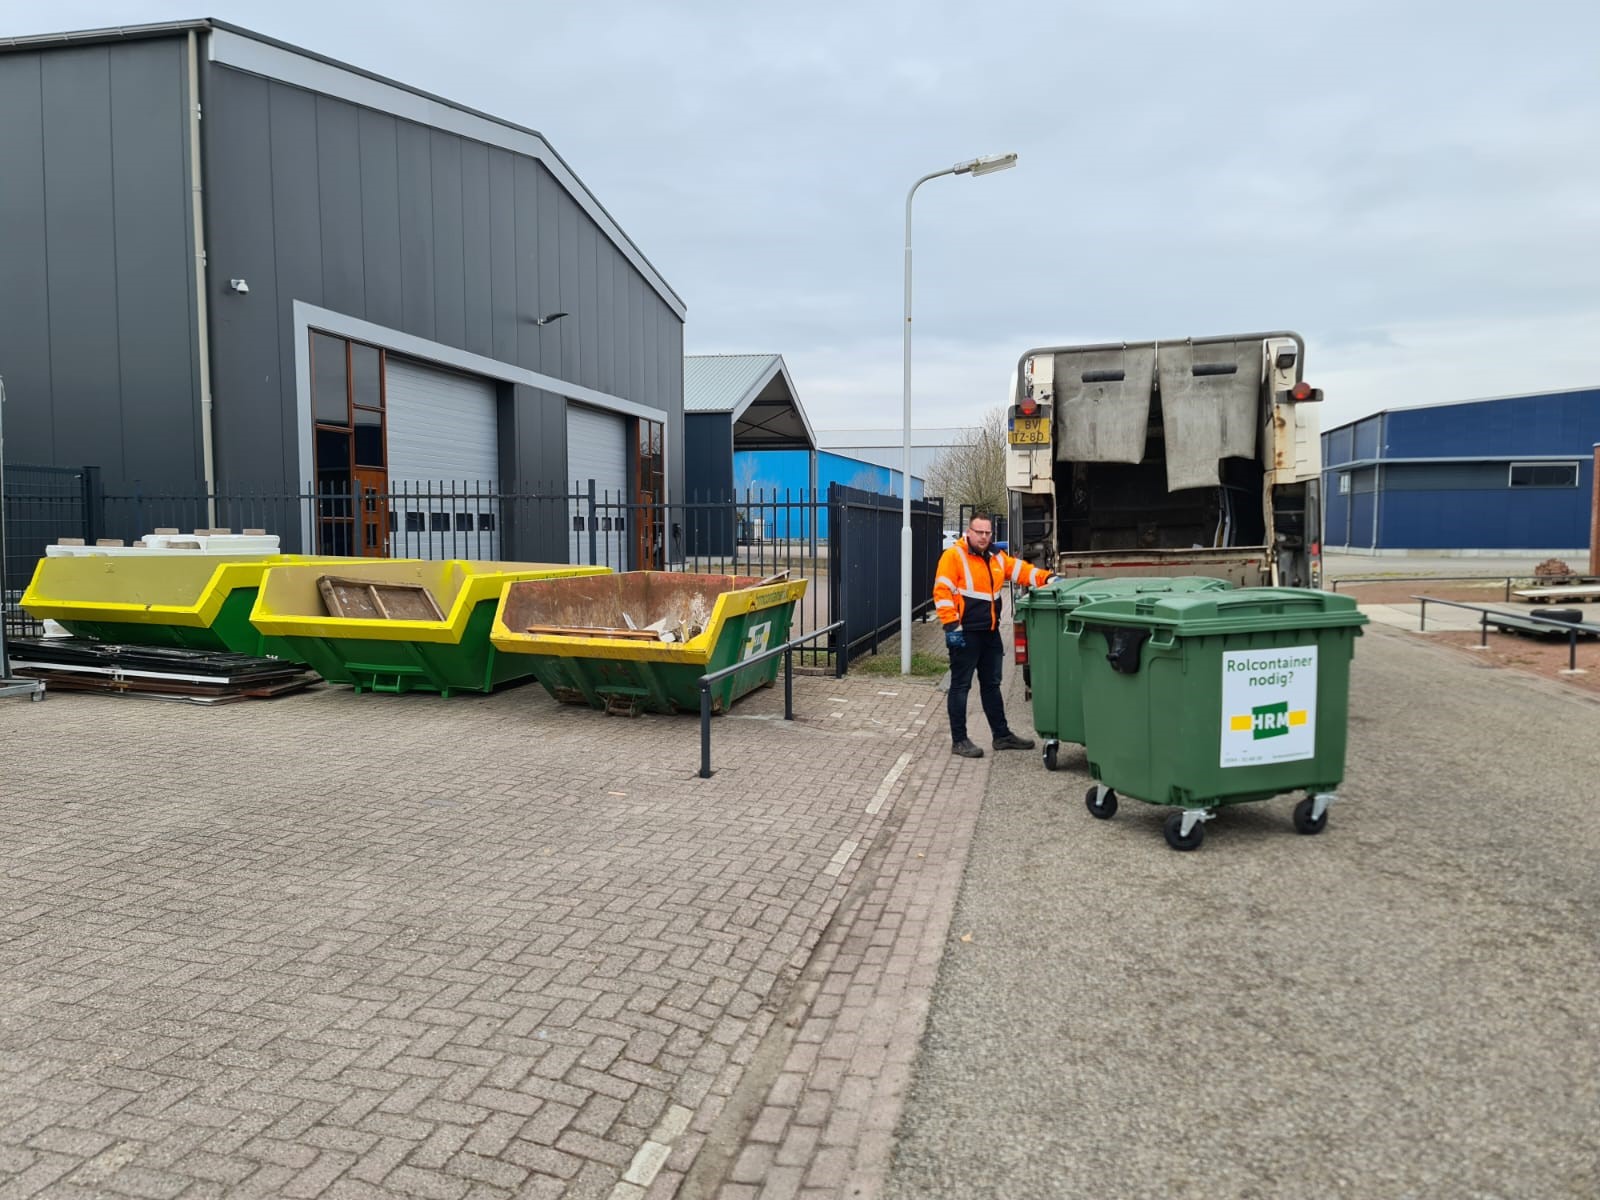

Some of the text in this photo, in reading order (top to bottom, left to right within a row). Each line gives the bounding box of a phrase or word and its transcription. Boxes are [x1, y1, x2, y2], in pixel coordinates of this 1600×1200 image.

[1014, 432, 1043, 441] TZ-80
[1227, 656, 1312, 672] Rolcontainer
[1249, 671, 1294, 687] nodig?
[1252, 712, 1289, 730] HRM
